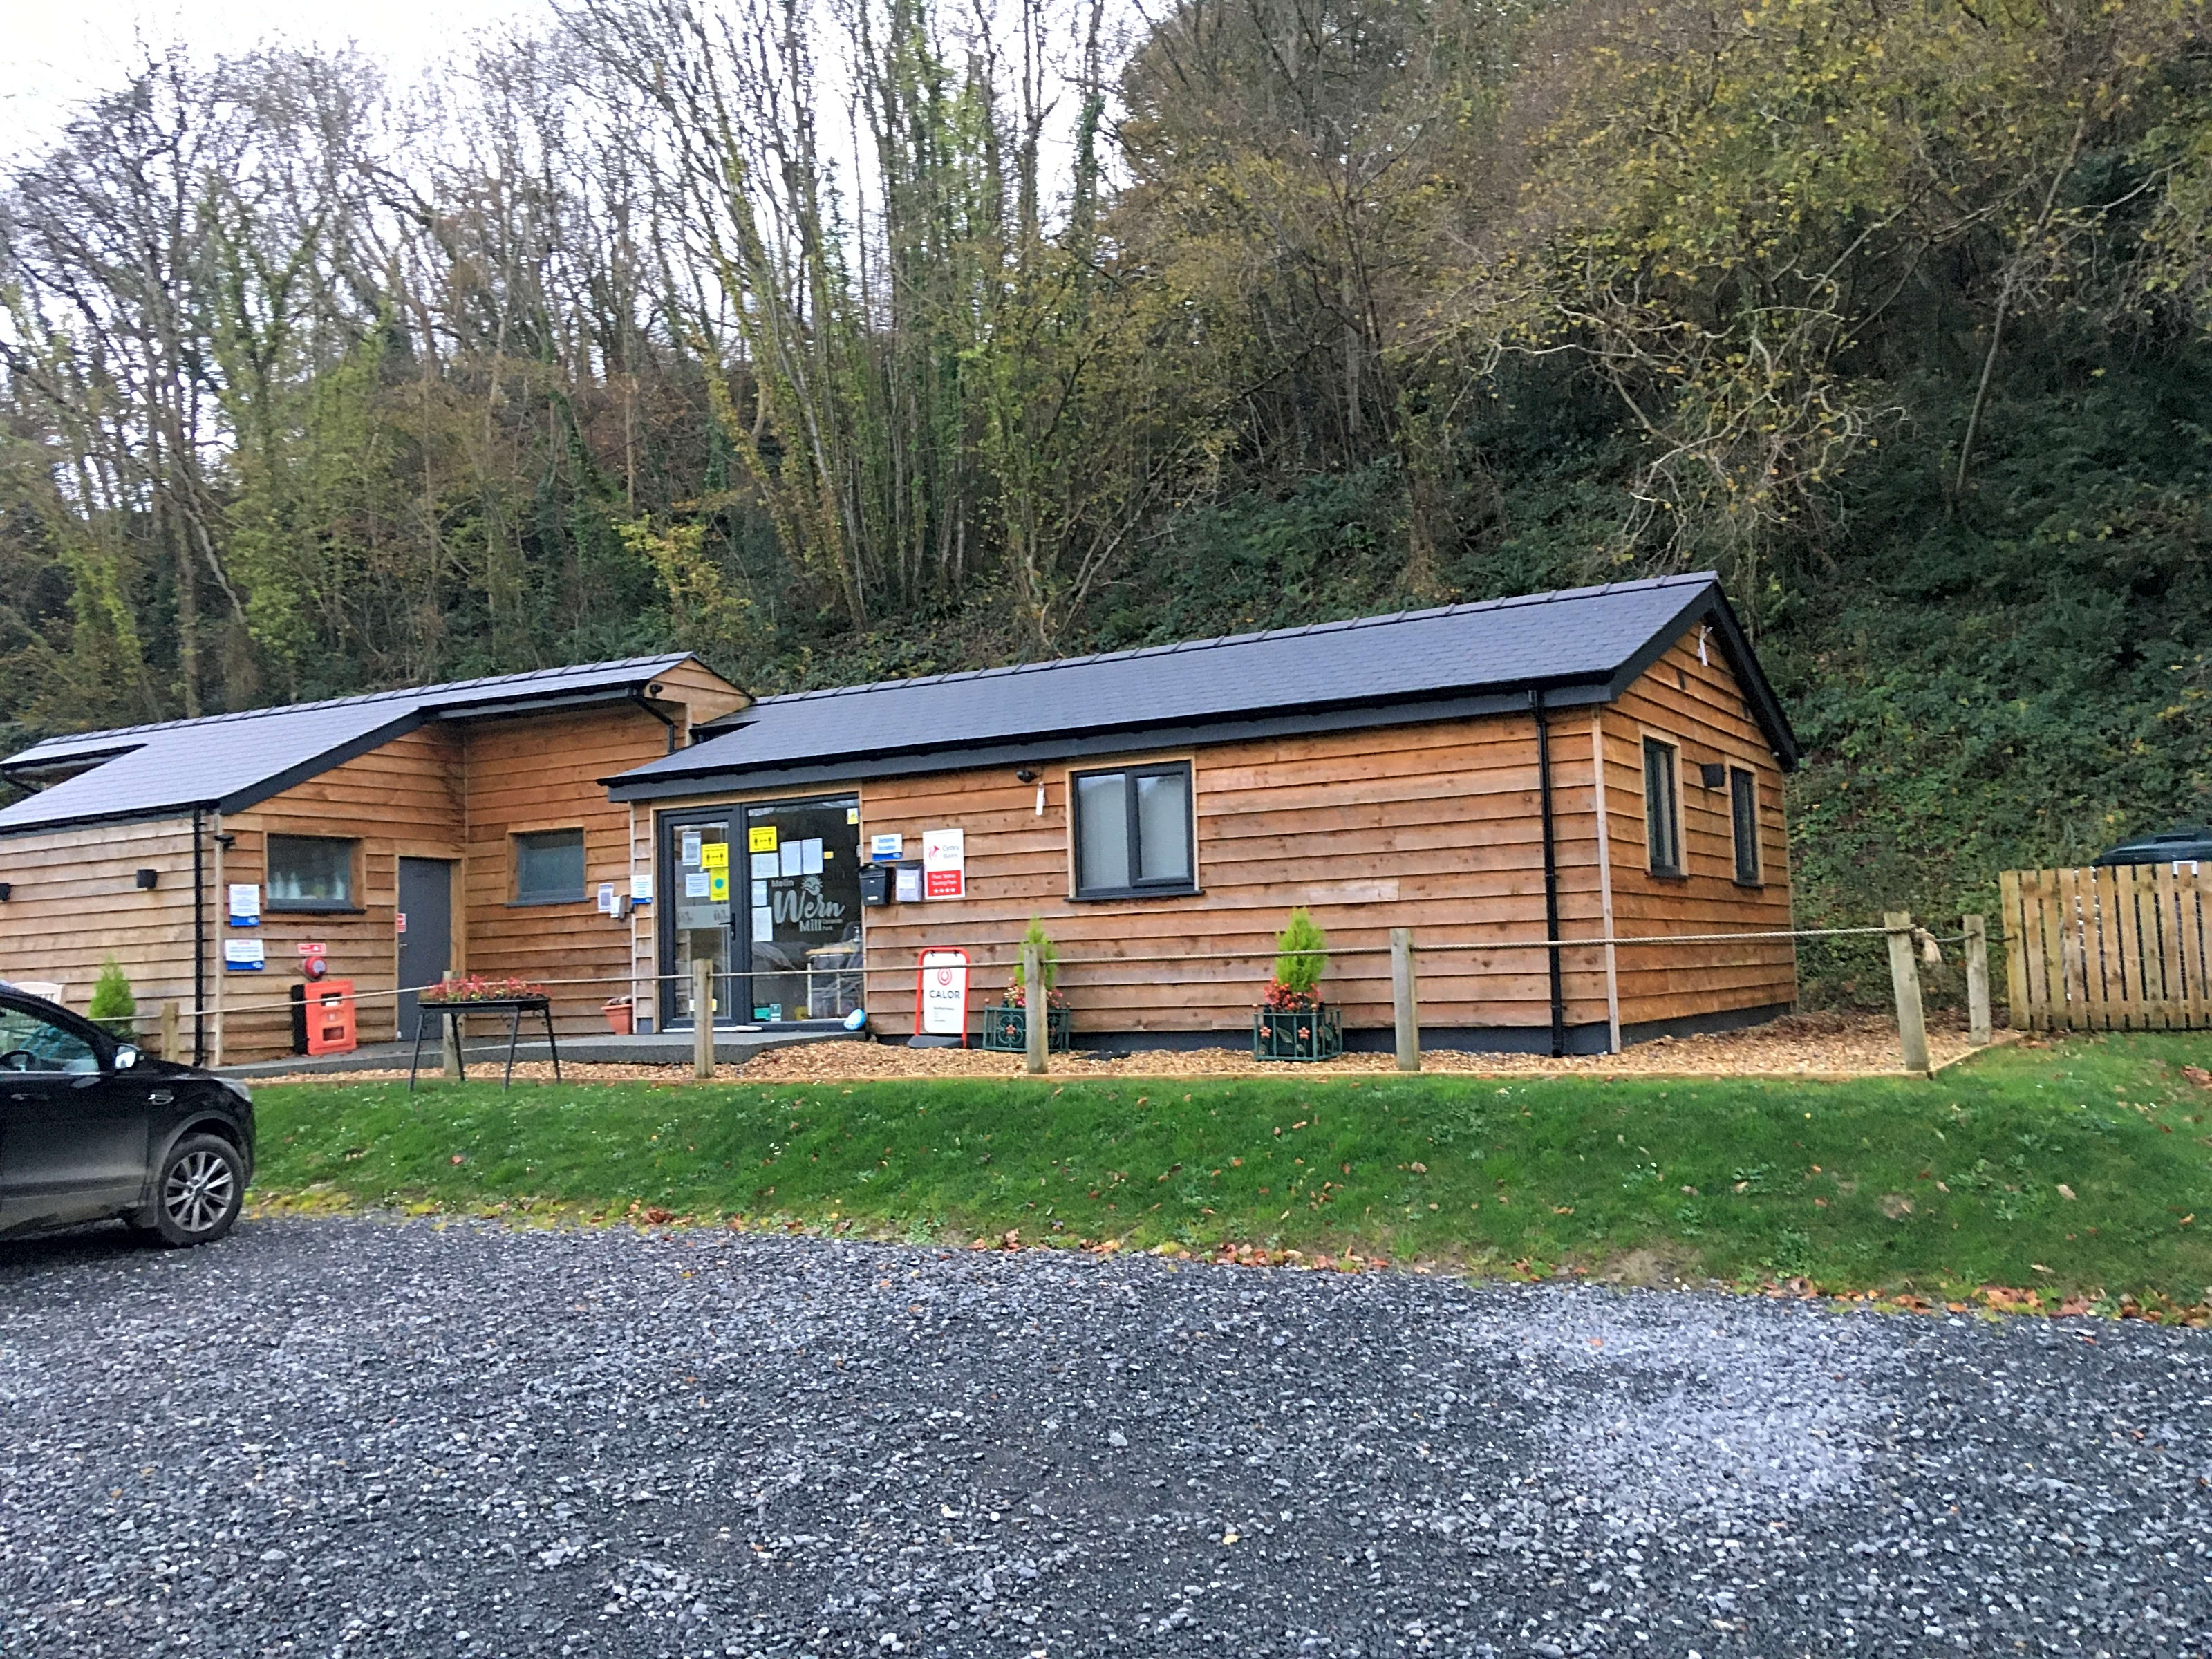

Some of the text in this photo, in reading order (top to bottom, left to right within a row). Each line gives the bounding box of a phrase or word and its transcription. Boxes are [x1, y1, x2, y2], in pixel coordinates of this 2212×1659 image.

[773, 890, 846, 924] Wern
[799, 919, 822, 932] Mill
[929, 989, 961, 999] CALOR
